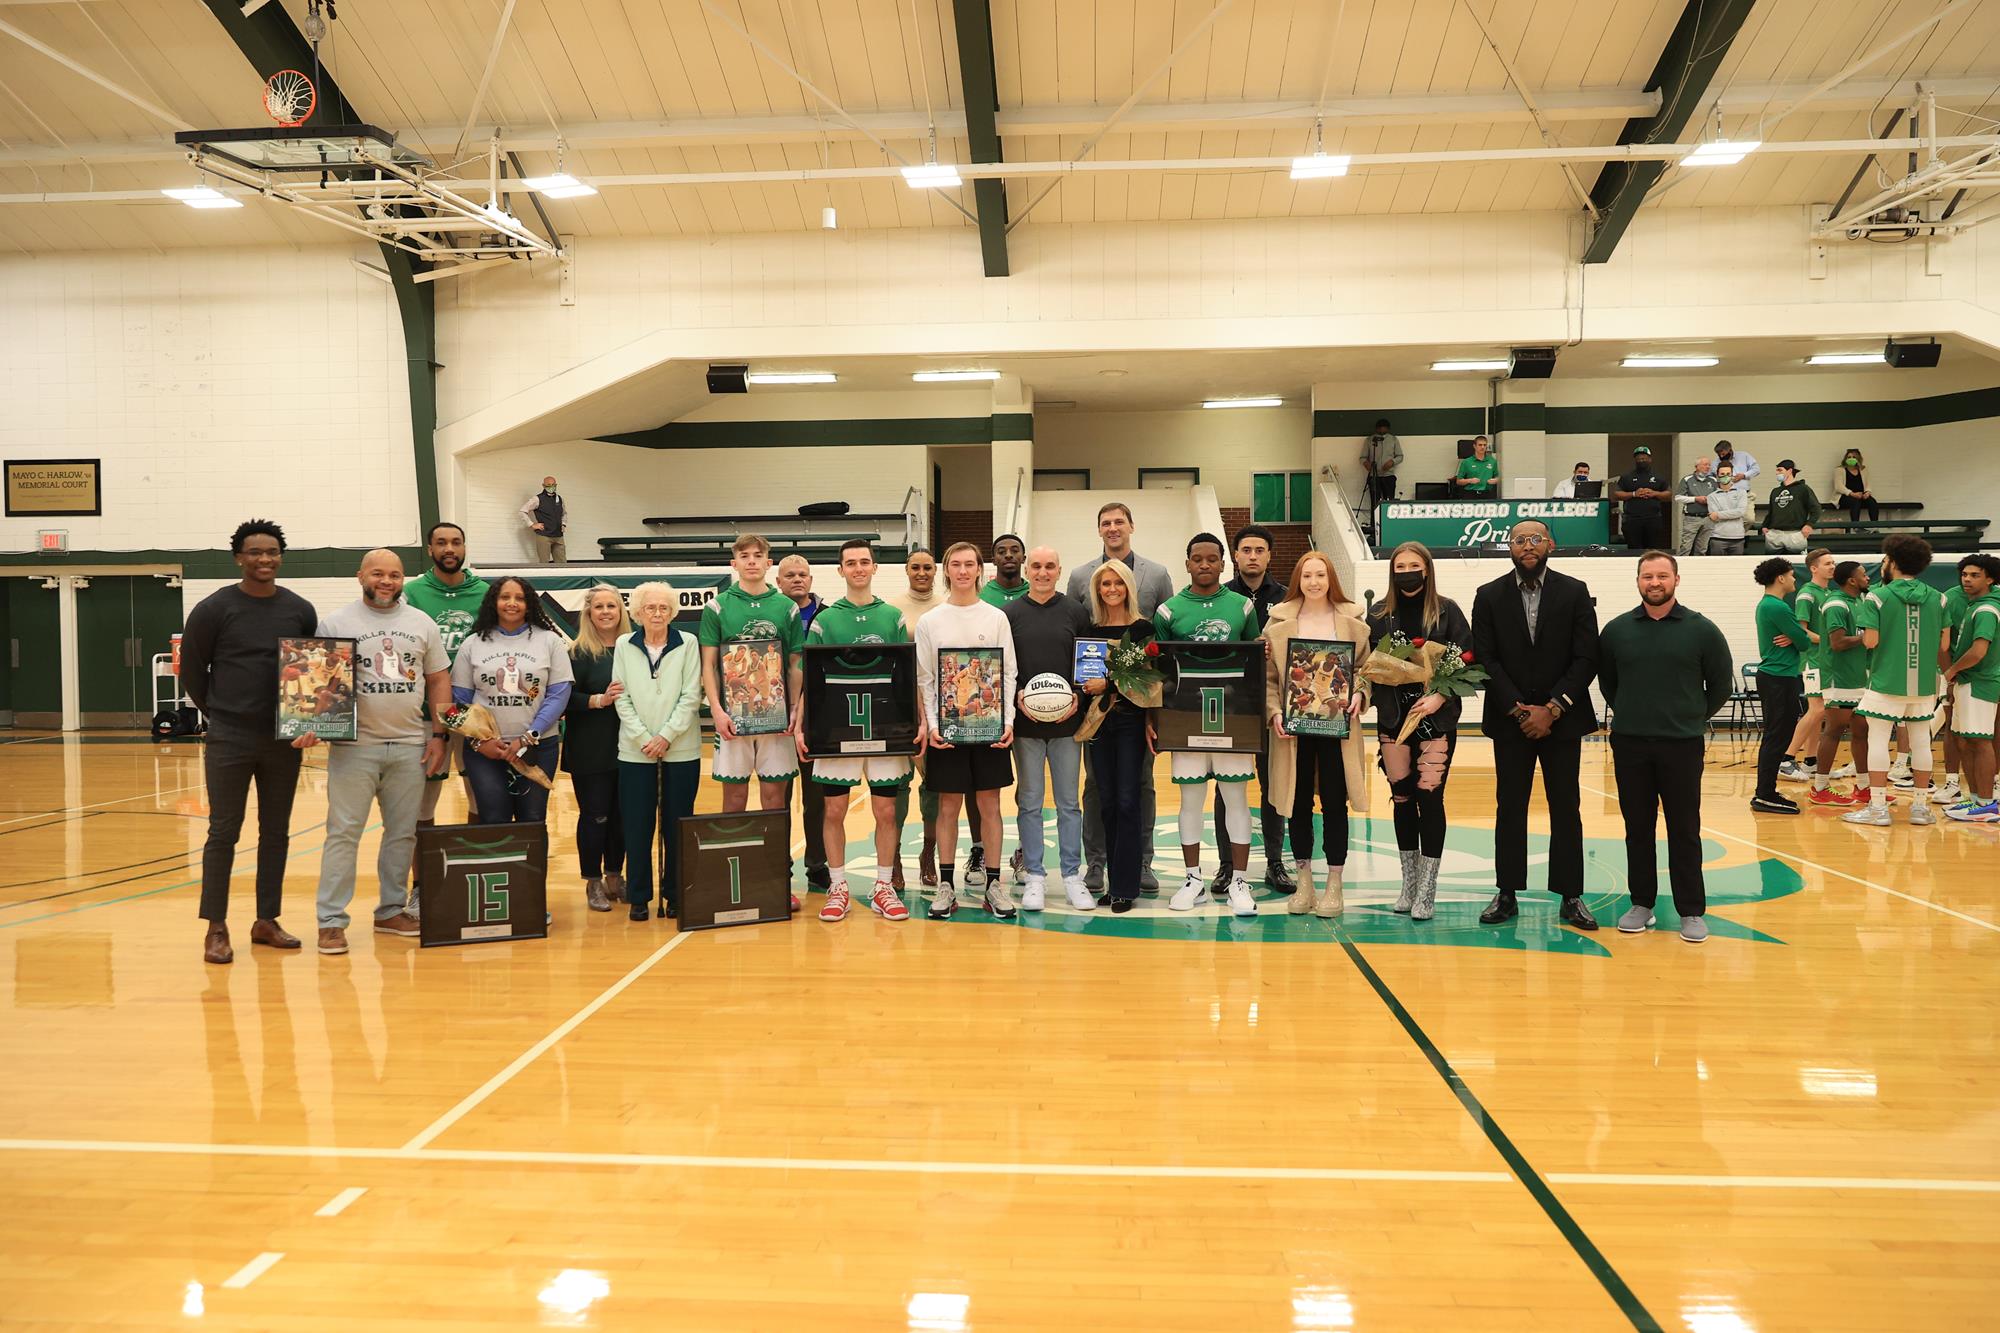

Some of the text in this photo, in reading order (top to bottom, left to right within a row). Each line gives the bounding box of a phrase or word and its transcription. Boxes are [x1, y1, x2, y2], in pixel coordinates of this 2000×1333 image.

[18, 481, 60, 489] MEMORIAL
[1386, 502, 1600, 519] GREENSBORO COLLEGE
[44, 534, 60, 548] EXIT
[1458, 518, 1511, 547] Pri
[391, 631, 416, 643] KRIS
[1908, 604, 1919, 670] PRIDE
[482, 652, 536, 664] KILLA KRIS
[1031, 680, 1064, 691] Wilson
[846, 693, 872, 740] 4
[1200, 687, 1225, 733] 0
[1301, 720, 1344, 731] GREENSBORO
[727, 856, 741, 904] 1
[465, 872, 509, 922] 15
